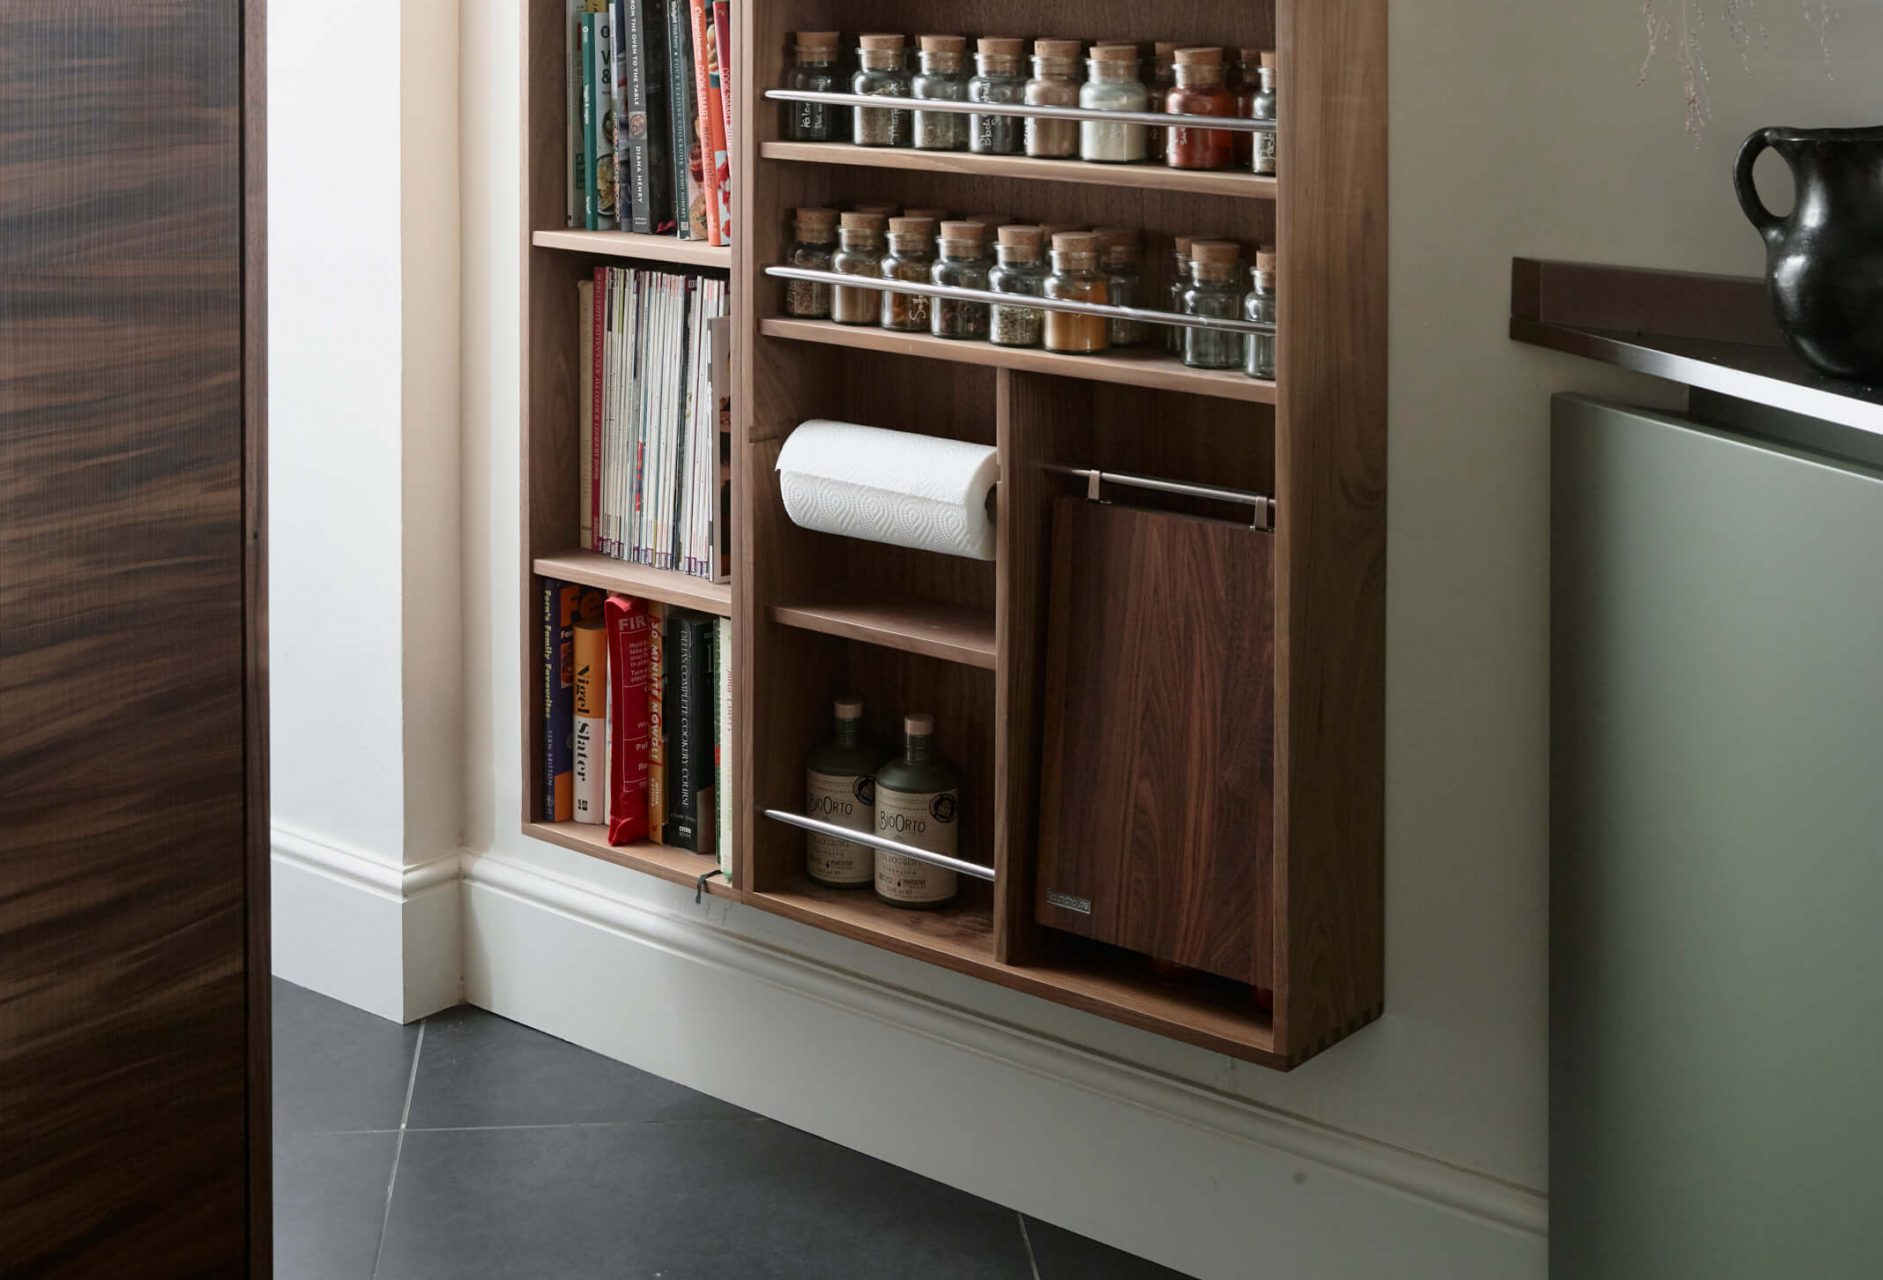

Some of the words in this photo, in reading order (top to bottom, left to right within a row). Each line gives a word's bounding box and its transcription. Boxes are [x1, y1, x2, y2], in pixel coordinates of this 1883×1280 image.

[632, 55, 639, 67] TO
[673, 58, 681, 80] FOUR
[698, 64, 708, 89] COOK
[721, 67, 730, 87] COOK
[633, 83, 641, 106] TABLE
[674, 82, 683, 117] SEASONS
[699, 90, 710, 121] SMART
[723, 88, 733, 121] SMART
[676, 119, 685, 166] COOKBOOK
[635, 146, 643, 173] DIANA
[636, 175, 645, 204] HENRY
[544, 589, 553, 622] Fern's
[618, 614, 648, 632] FIR
[650, 621, 660, 640] 30
[543, 624, 553, 660] Family
[680, 630, 690, 663] DELIA'S
[650, 644, 660, 697] MINUTE
[544, 663, 553, 718] Favourites
[576, 664, 592, 714] Nigel
[680, 663, 690, 716] COMPLETE
[650, 702, 660, 760] MOWGLI
[680, 717, 690, 765] COOKERY
[576, 721, 592, 782] Slater
